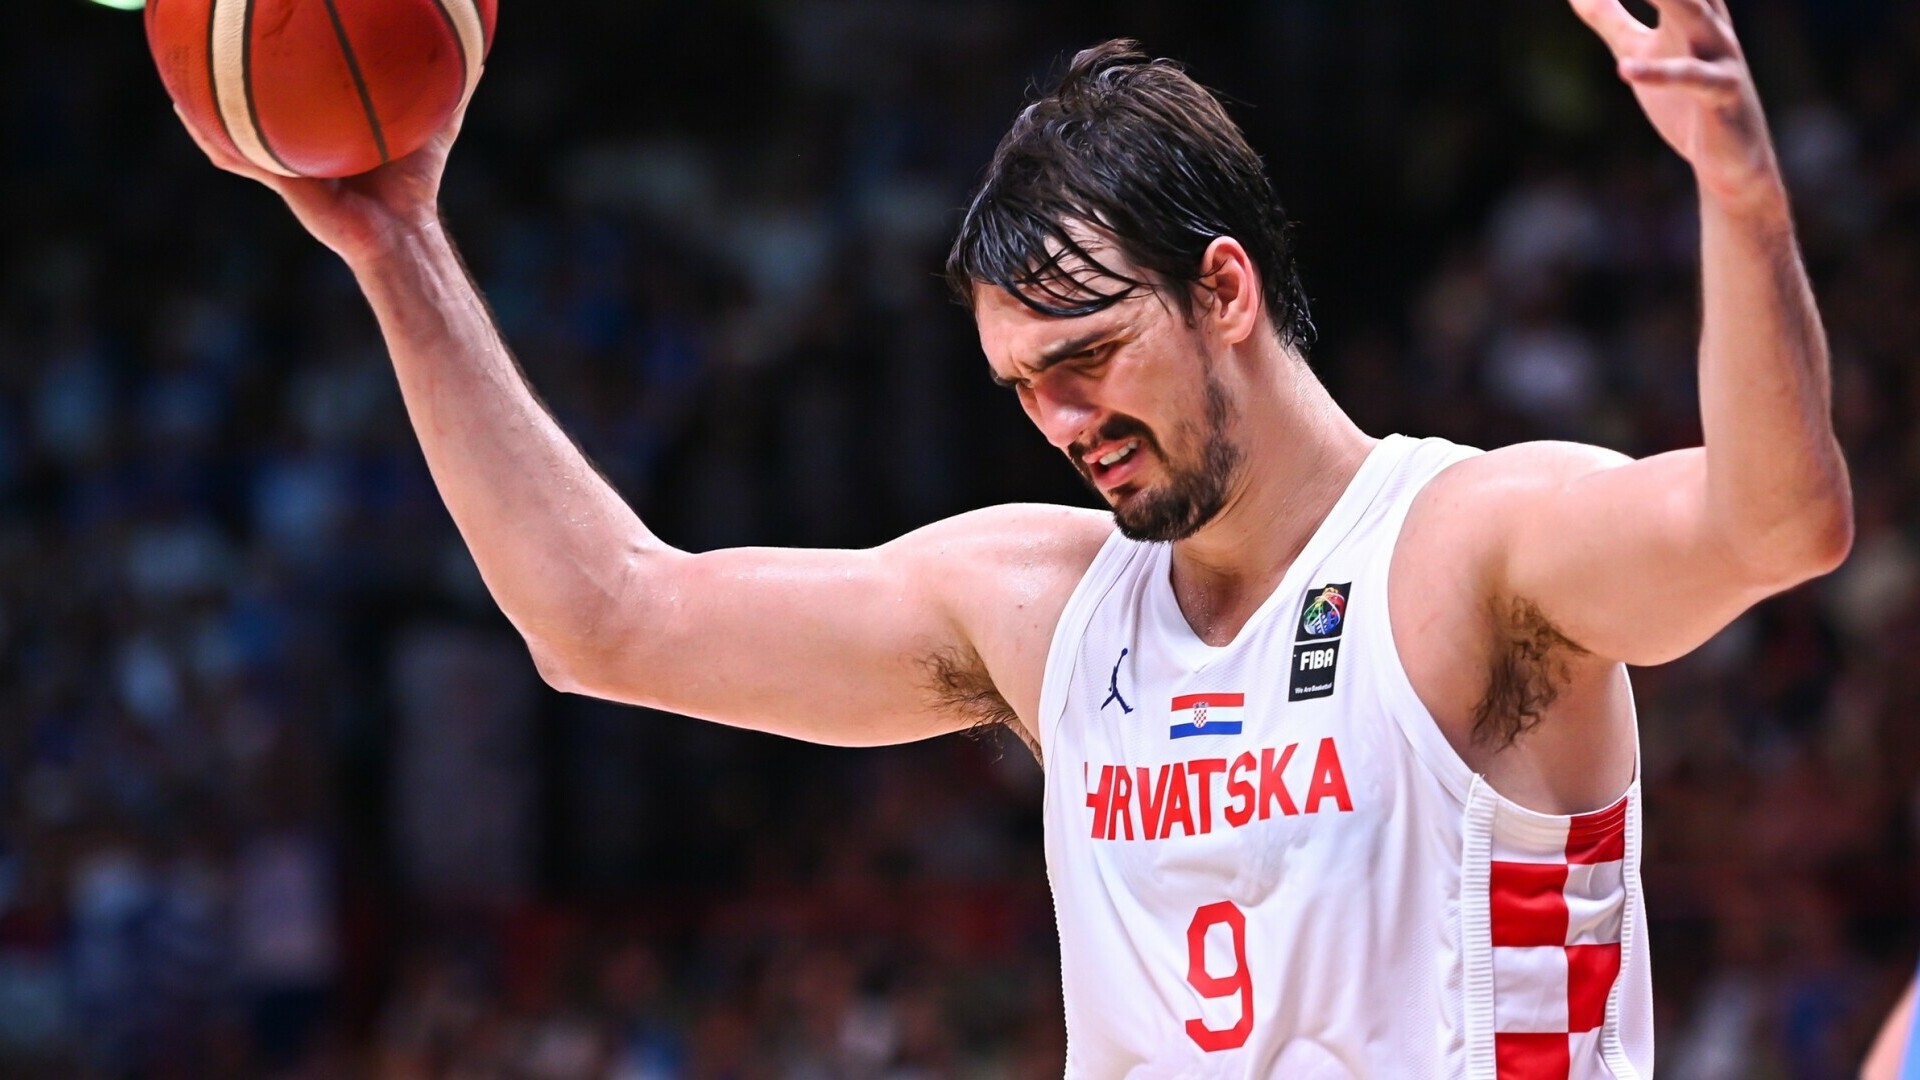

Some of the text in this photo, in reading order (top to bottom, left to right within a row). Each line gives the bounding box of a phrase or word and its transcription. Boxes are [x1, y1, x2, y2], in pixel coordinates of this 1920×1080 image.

[1300, 648, 1334, 670] FIBA
[1084, 737, 1354, 841] HRVATSKA
[1185, 900, 1254, 1053] 9
